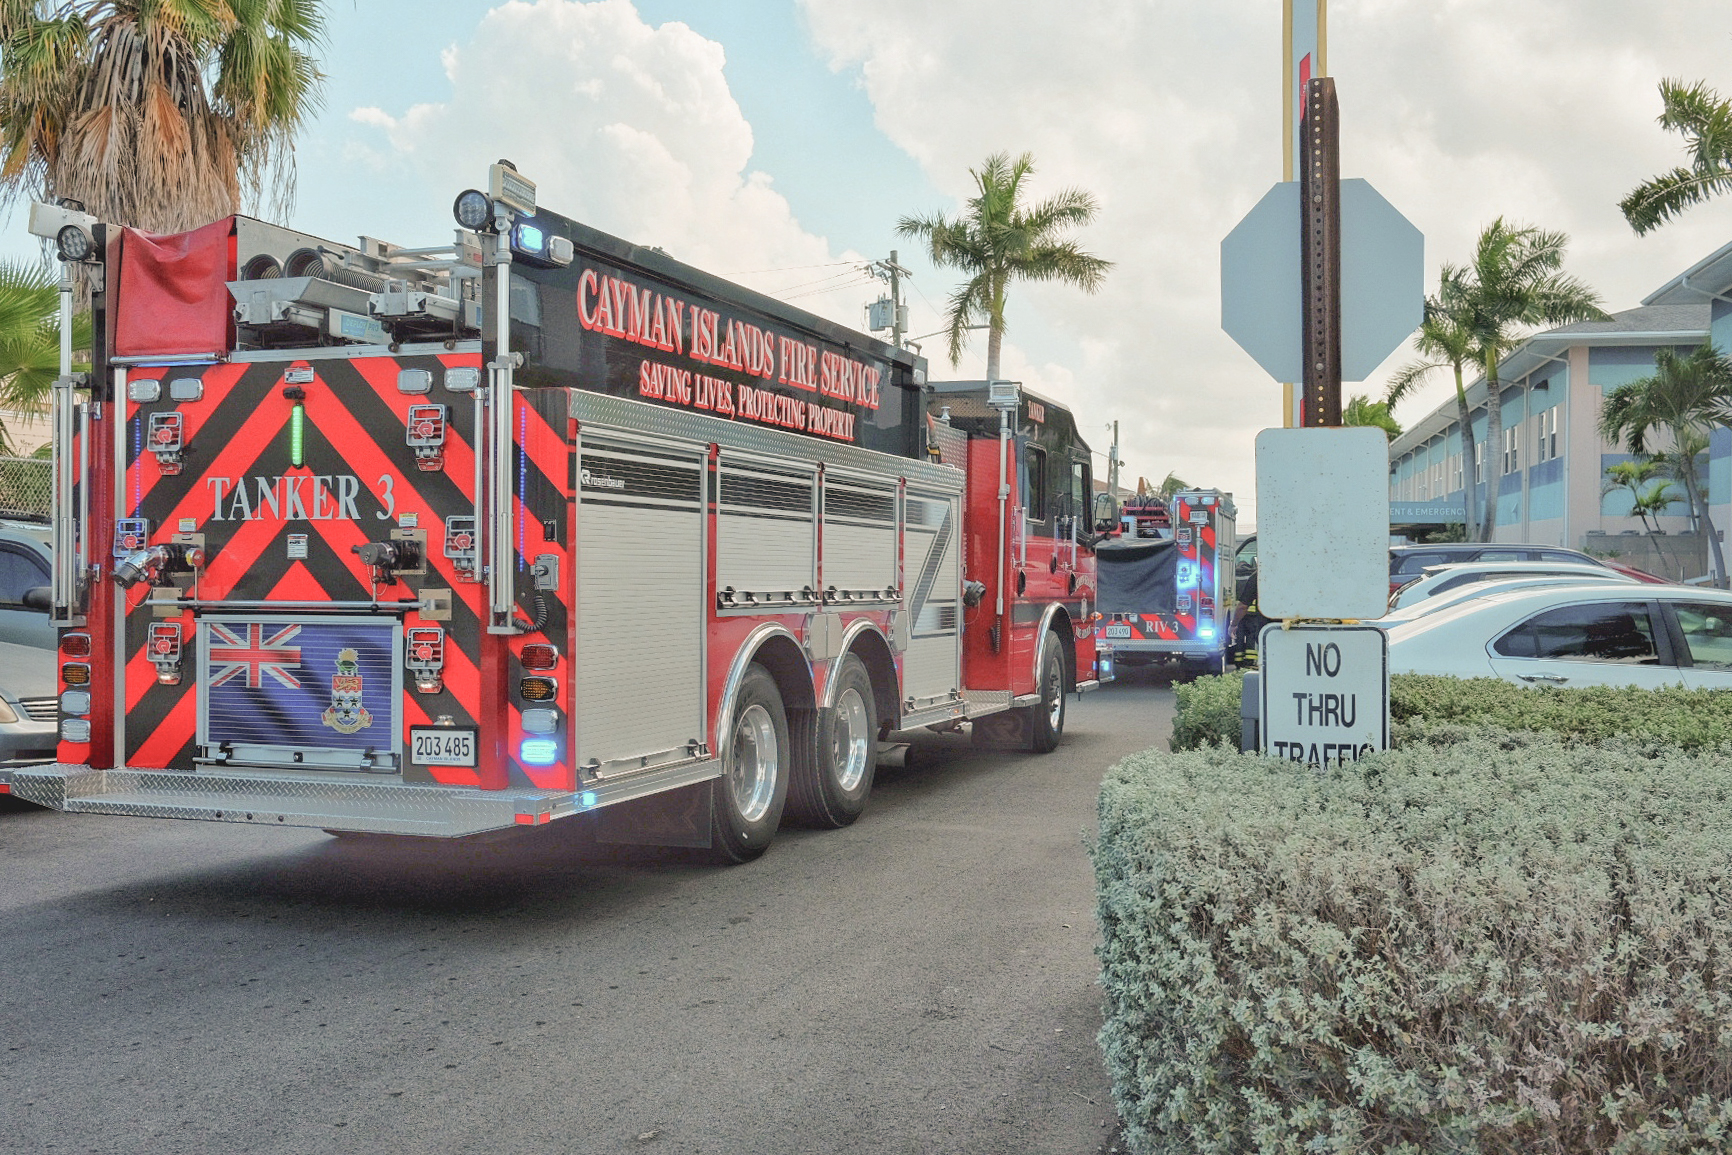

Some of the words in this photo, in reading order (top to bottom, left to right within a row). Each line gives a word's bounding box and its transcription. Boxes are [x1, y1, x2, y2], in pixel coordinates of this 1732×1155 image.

[577, 268, 685, 355] CAYMAN
[689, 304, 774, 380] ISLANDS
[778, 334, 817, 392] FIRE
[820, 350, 880, 410] SERVICE
[640, 360, 692, 405] SAVING
[694, 373, 736, 421] LIVES,
[738, 383, 806, 430] PROTECTING
[807, 402, 855, 441] PROPERTY
[207, 474, 361, 521] TANKER
[376, 473, 395, 520] 3
[1415, 507, 1467, 516] EMERGENCY
[1145, 620, 1168, 633] RIV
[1172, 620, 1179, 633] 3
[1306, 642, 1341, 677] NO
[1292, 692, 1356, 728] THRU
[416, 736, 441, 756] 203
[444, 737, 470, 757] 485
